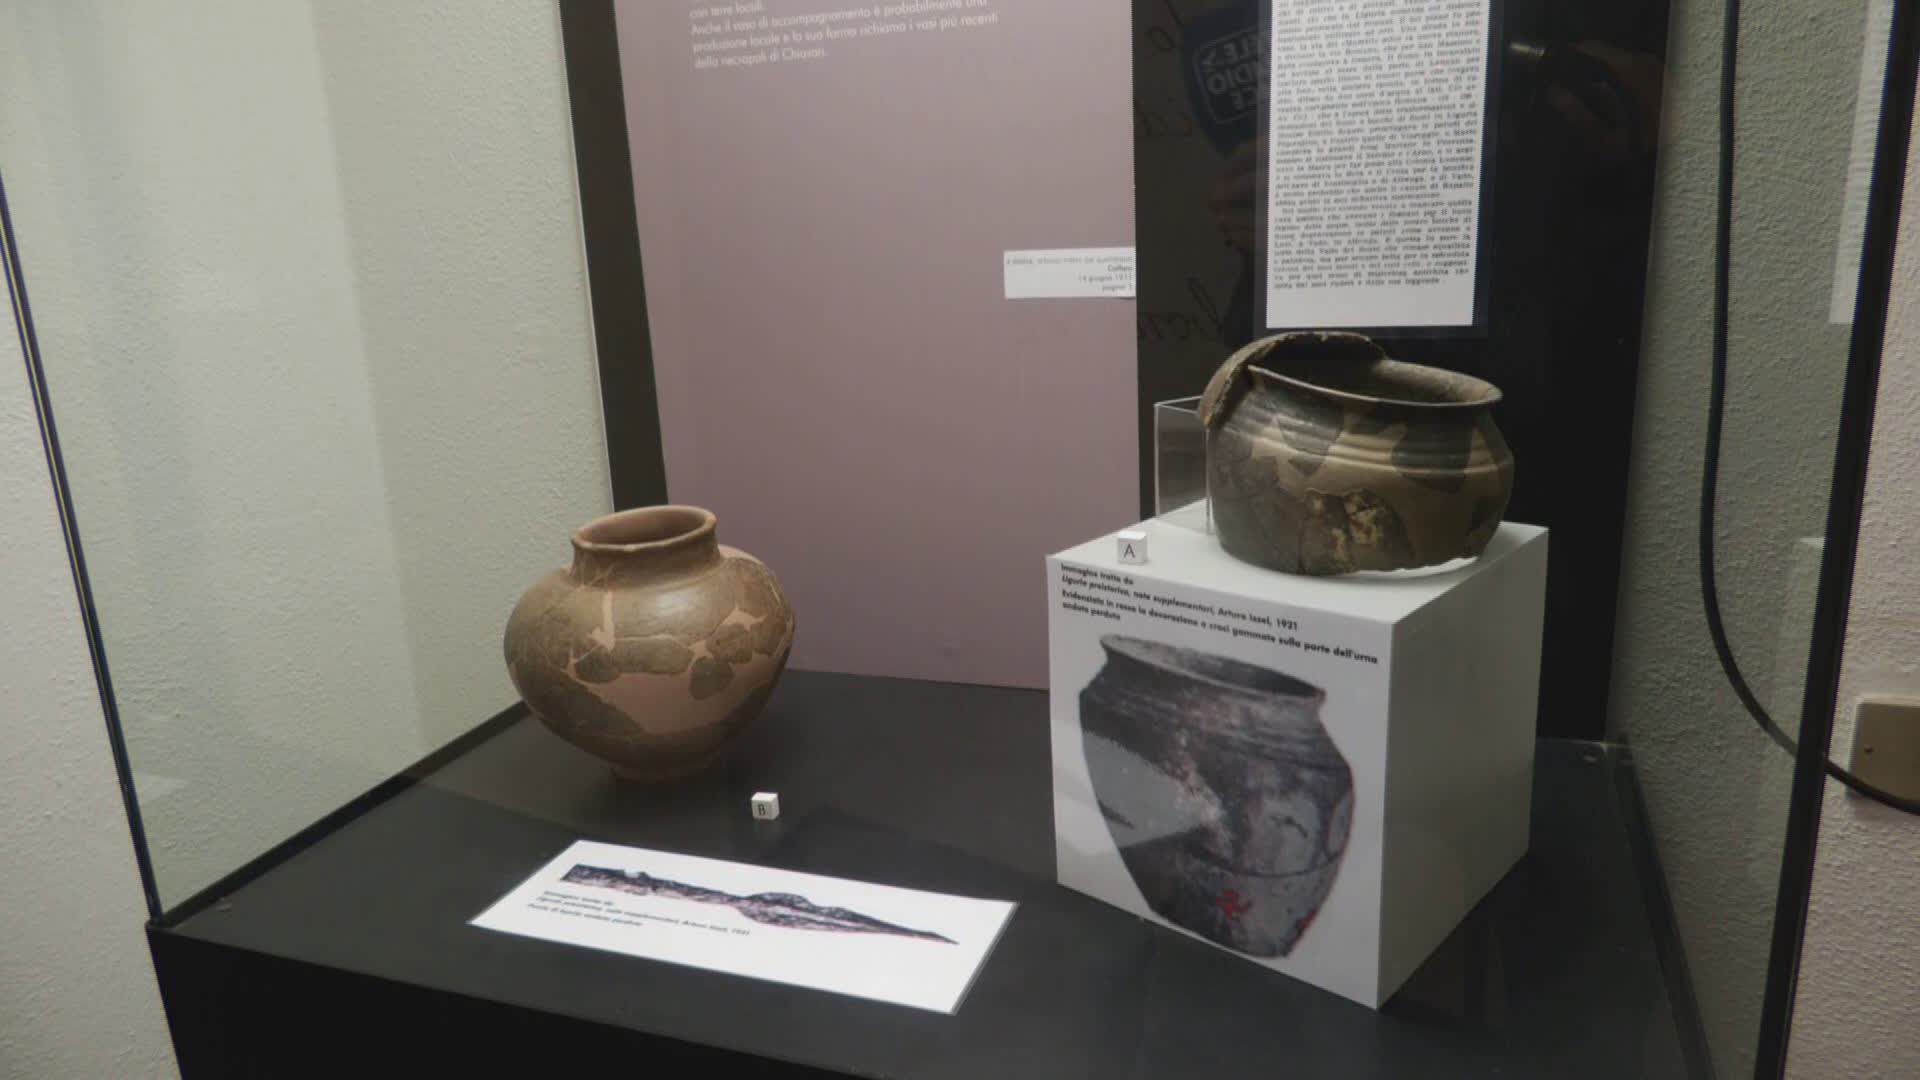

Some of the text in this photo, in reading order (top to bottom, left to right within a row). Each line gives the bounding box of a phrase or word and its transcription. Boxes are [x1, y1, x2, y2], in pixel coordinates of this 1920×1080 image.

[691, 21, 721, 33] Anche
[733, 21, 756, 32] vaso
[758, 16, 768, 28] di
[693, 36, 747, 54] produzione
[750, 32, 780, 47] locale
[792, 30, 802, 41] la
[804, 30, 823, 41] sua
[959, 11, 999, 26] recenti
[1123, 543, 1136, 559] A
[1061, 562, 1134, 586] Immagine tratta da
[1062, 574, 1088, 588] Liguria
[1089, 581, 1131, 598] preistorica,
[1133, 591, 1151, 601] note
[1217, 606, 1247, 621] Arturo
[1062, 601, 1121, 622] andata perduta
[1106, 597, 1115, 607] in
[1116, 602, 1137, 614] rosso
[1138, 604, 1147, 615] la
[1148, 607, 1199, 627] decorazione
[1209, 622, 1230, 633] croci
[1232, 627, 1276, 643] gammate
[1278, 637, 1301, 648] sulla
[1304, 642, 1331, 655] parte
[1333, 645, 1378, 664] dell'urna
[758, 803, 766, 817] B
